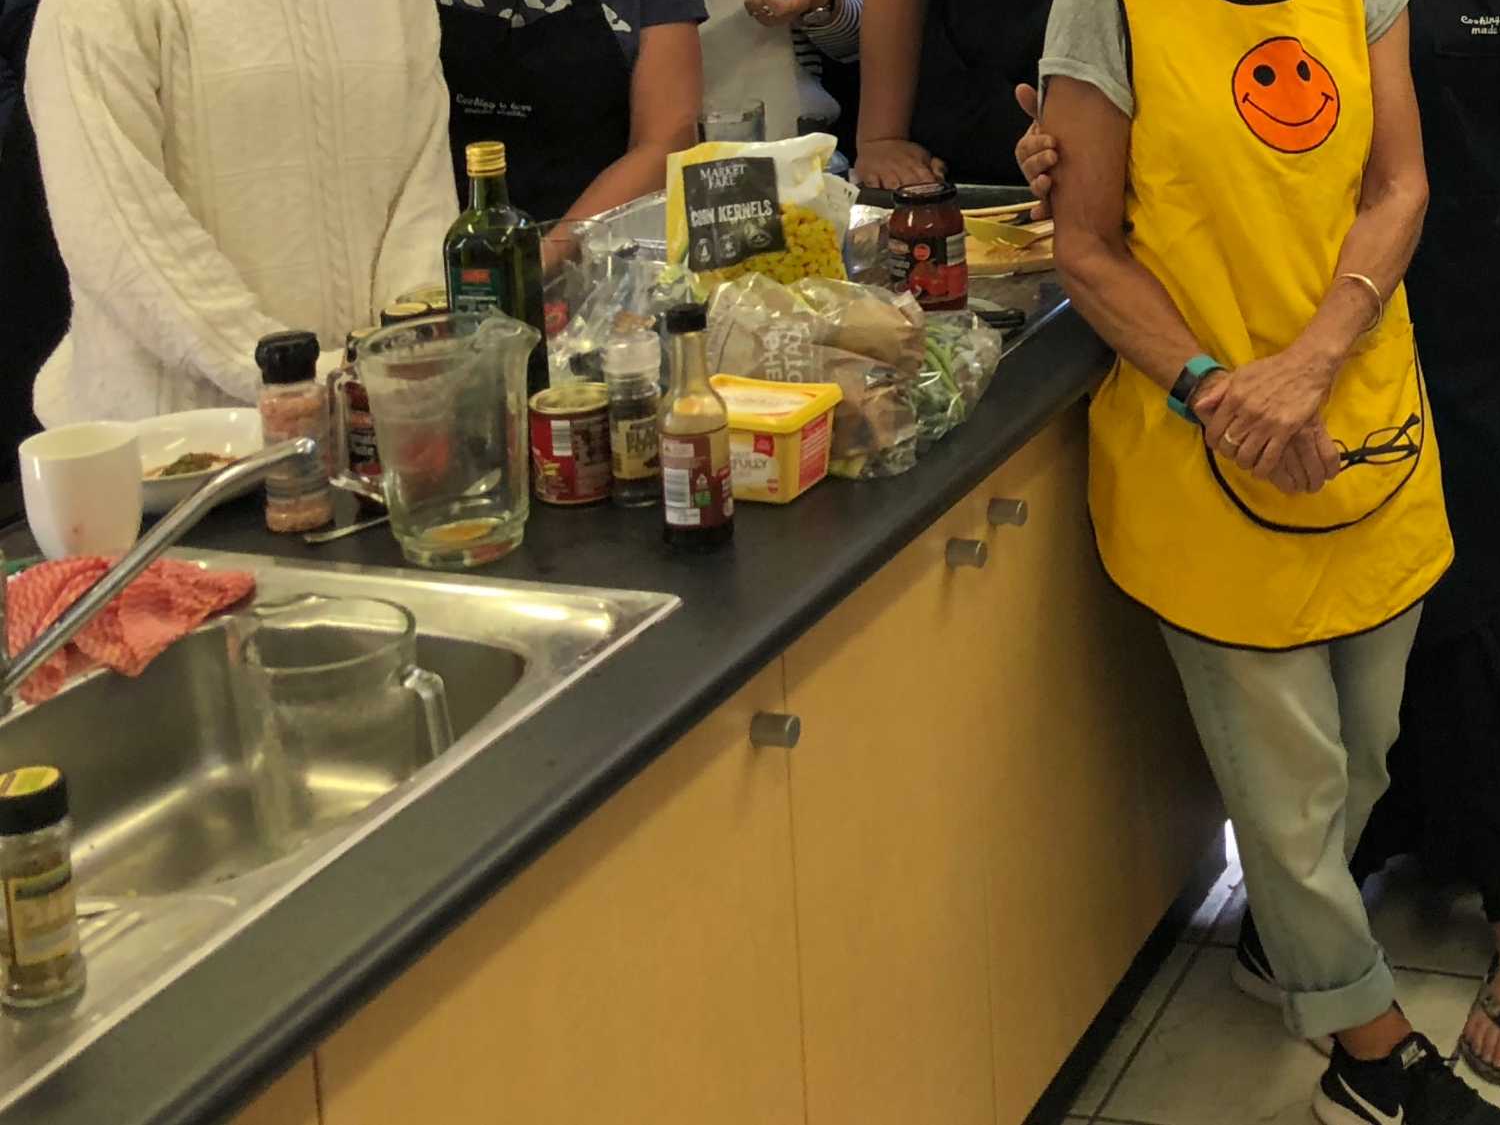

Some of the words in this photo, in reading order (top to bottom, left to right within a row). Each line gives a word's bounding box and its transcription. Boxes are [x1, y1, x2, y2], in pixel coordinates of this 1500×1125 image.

[1460, 15, 1500, 26] Cooking
[1471, 25, 1498, 34] made
[699, 163, 747, 180] MARKET
[718, 199, 773, 223] KERNELS
